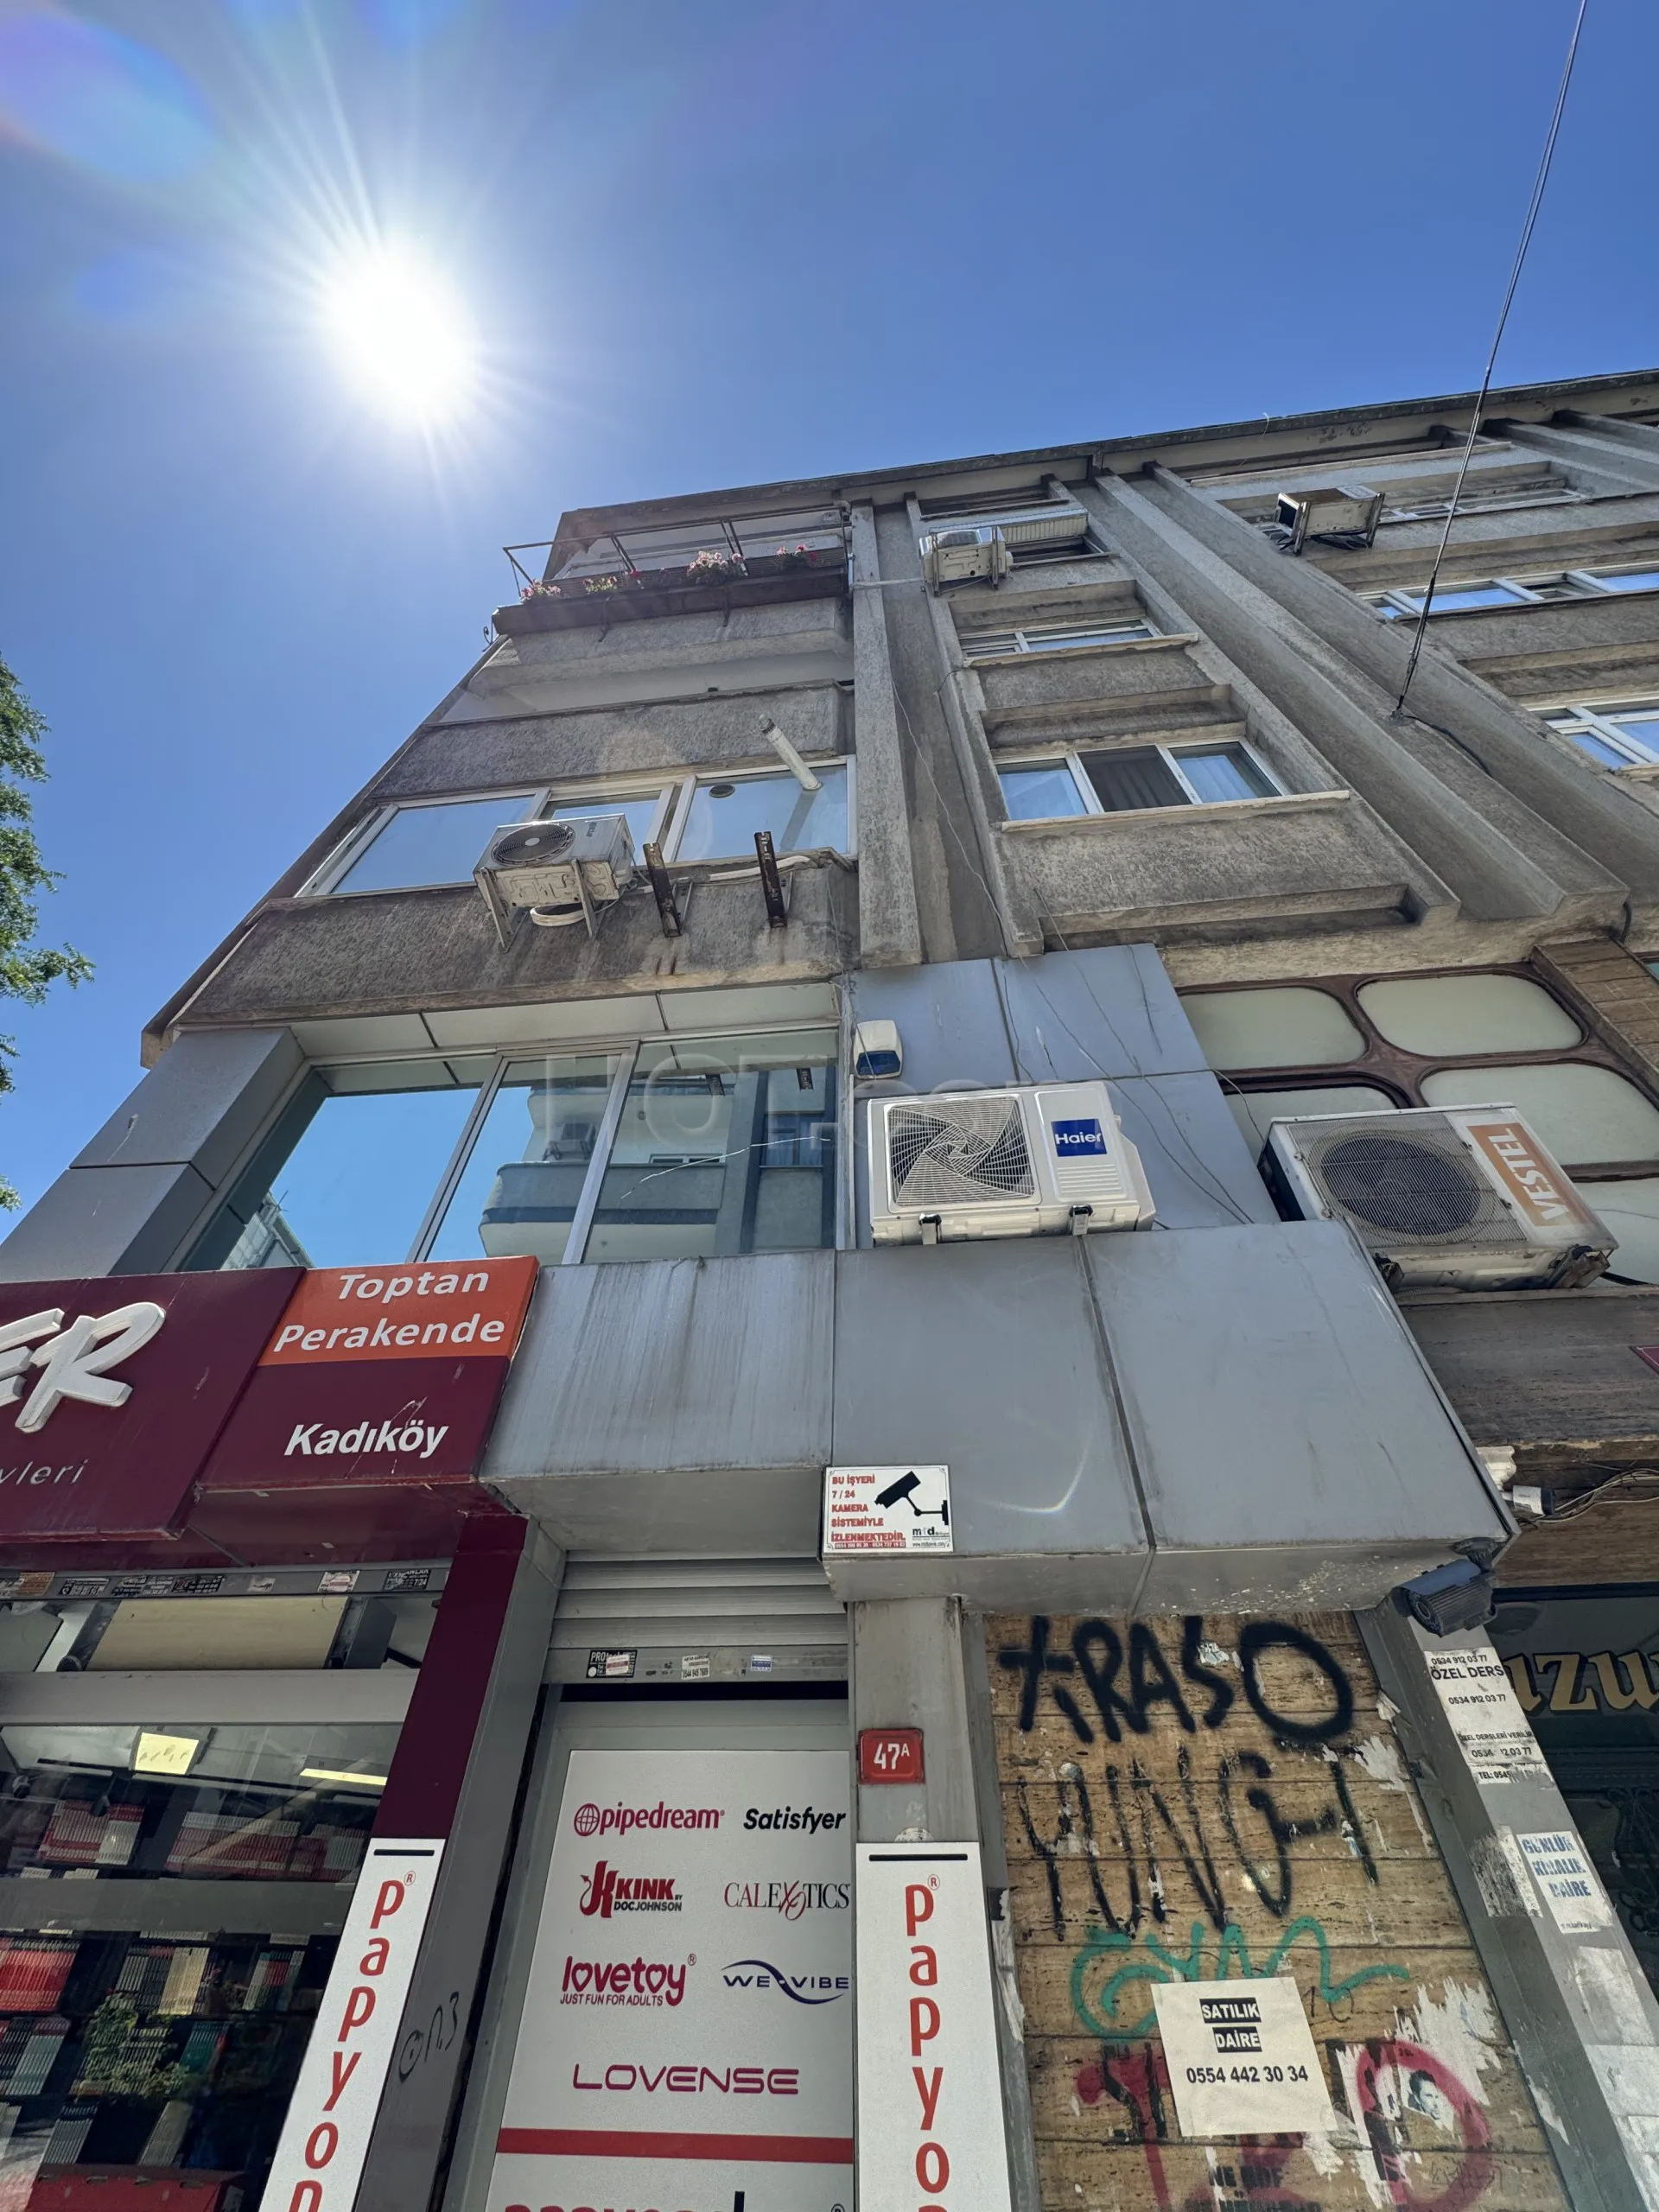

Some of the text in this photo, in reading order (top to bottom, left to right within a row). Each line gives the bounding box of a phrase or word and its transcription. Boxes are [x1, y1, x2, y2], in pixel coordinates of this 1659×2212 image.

[1055, 1133, 1102, 1145] Haier
[1487, 1128, 1570, 1220] VESTEL
[338, 1271, 489, 1304] Toptan
[272, 1313, 505, 1352] Perakende
[283, 1419, 449, 1459] Kadıköy
[831, 1473, 875, 1486] BU İŞYERİ
[844, 1490, 855, 1499] 24
[831, 1503, 869, 1513] KAMERA
[831, 1516, 885, 1528] SİSTEMİYLE
[1431, 1656, 1452, 1666] 0534
[1453, 1656, 1465, 1665] 912
[1468, 1655, 1478, 1663] 03
[1431, 1665, 1504, 1680] ÖZEL DERS
[1448, 1696, 1469, 1705] 0534
[1471, 1694, 1484, 1703] 912
[1476, 1732, 1507, 1740] DERSLERİ
[599, 1802, 721, 1834] pipedream
[743, 1806, 847, 1834] Satisfyer
[613, 1878, 676, 1900] KINK
[562, 1955, 687, 2006] lovetoy
[560, 1994, 664, 2006] JUST FUN FOR ADULTS
[1200, 2002, 1262, 2020] SATILIK
[905, 1883, 950, 2212] papyo
[1214, 2026, 1262, 2049] DAİRE
[572, 2063, 800, 2095] LOVENSE
[1185, 2064, 1309, 2084] 0554 442 30 34
